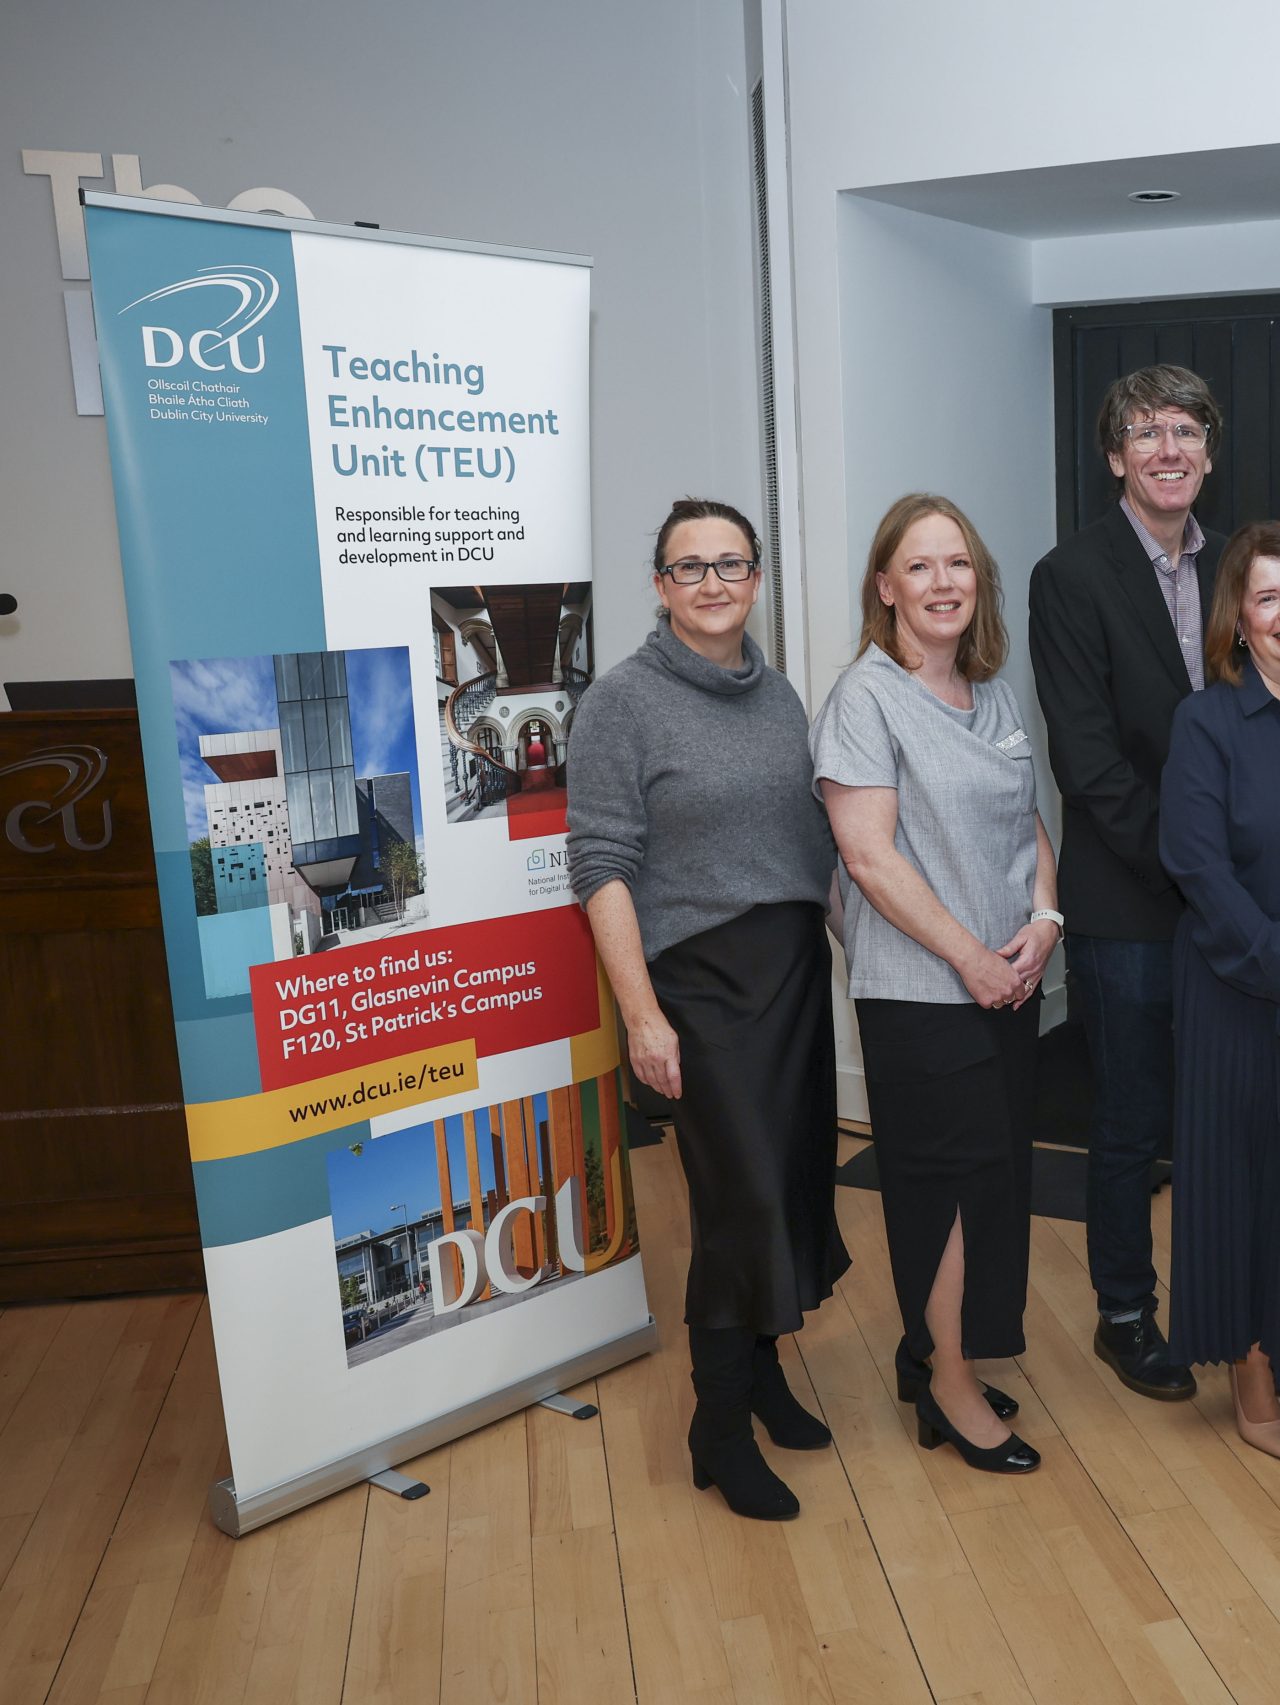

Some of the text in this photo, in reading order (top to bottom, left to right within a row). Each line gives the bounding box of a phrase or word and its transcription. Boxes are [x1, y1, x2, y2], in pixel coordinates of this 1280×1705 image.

[142, 326, 266, 374] DCU
[321, 345, 485, 396] Teaching
[147, 379, 241, 394] Ollscoil Chathair
[148, 393, 250, 408] Bhaile Átha Cliath
[150, 408, 269, 426] Dublin City University
[327, 394, 560, 436] Enhancement
[331, 443, 516, 483] Unit (TEU)
[335, 505, 520, 526] Responsible for teaching
[336, 525, 525, 546] and learning support and
[338, 547, 495, 567] development in DCU
[5, 800, 113, 853] CU
[528, 875, 555, 886] National
[529, 888, 538, 896] for
[540, 884, 560, 894] Digital
[274, 949, 454, 1001] Where to find us:
[279, 960, 537, 1031] DG11, Glasnevin Campus
[282, 984, 544, 1061] F120, St Patrick's Campus
[288, 1063, 466, 1124] www.dcu.ie/teu
[428, 1144, 625, 1317] DCU
